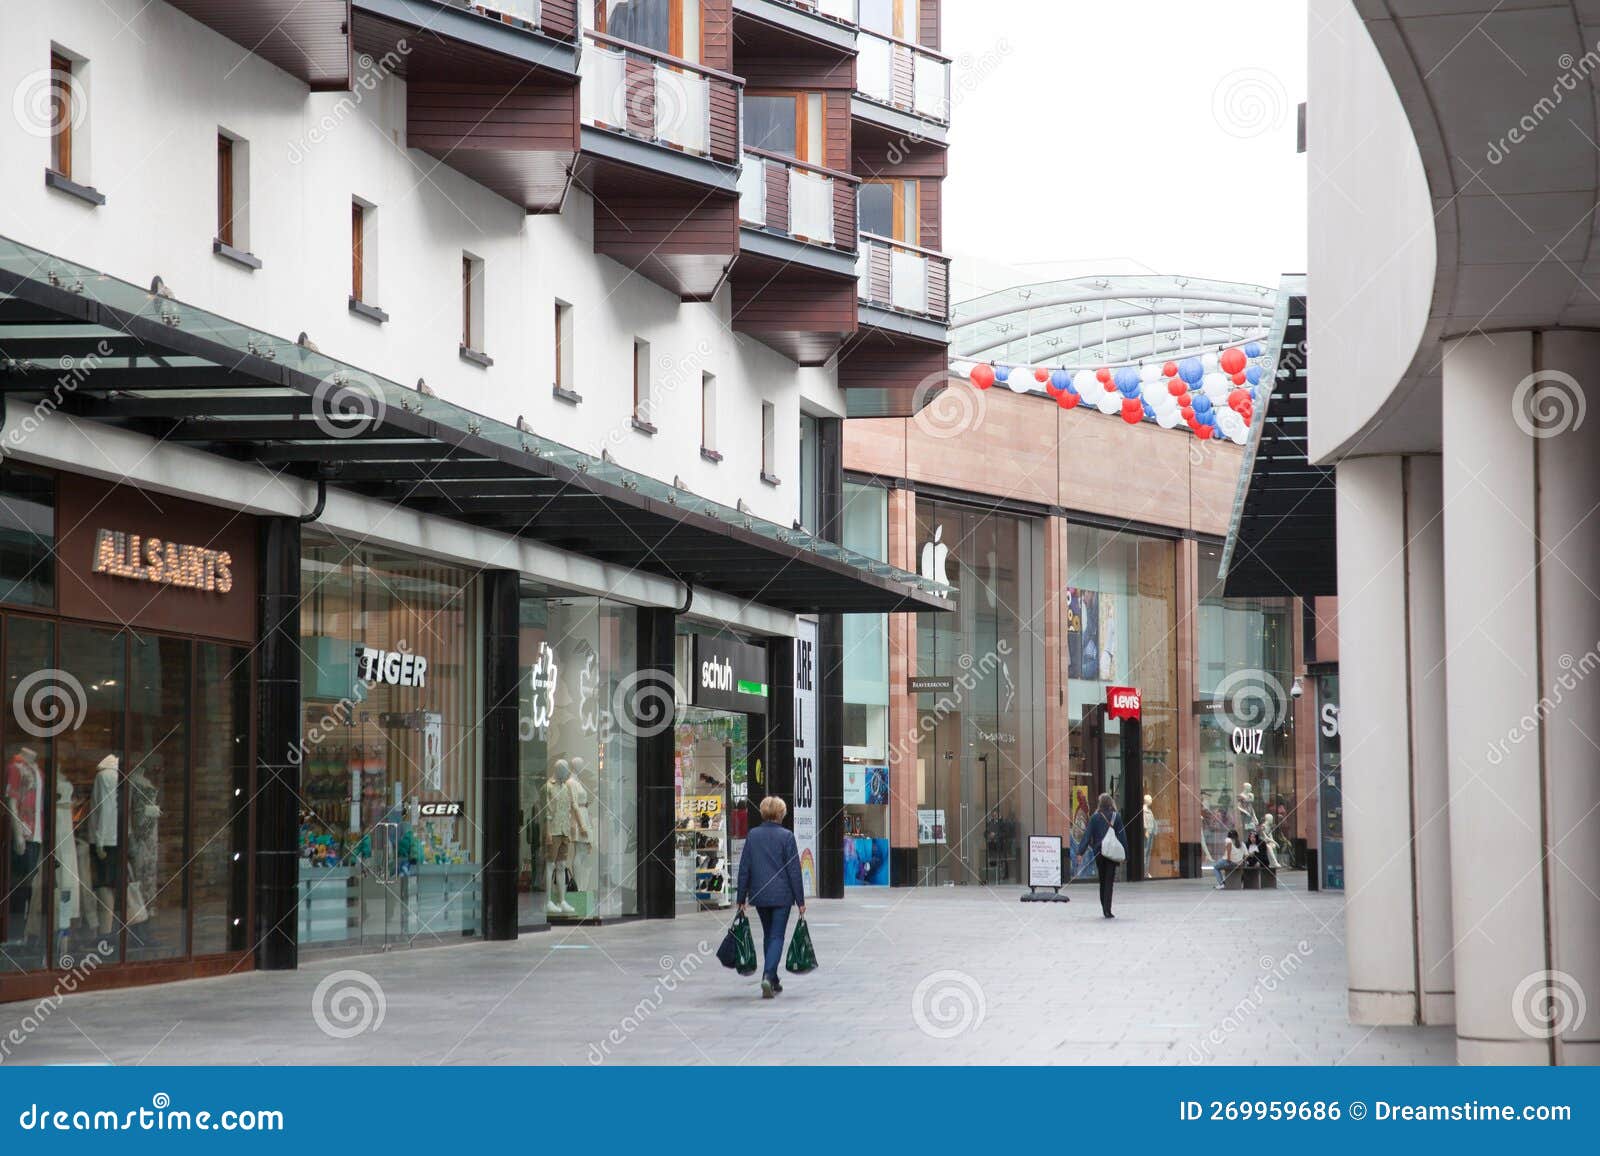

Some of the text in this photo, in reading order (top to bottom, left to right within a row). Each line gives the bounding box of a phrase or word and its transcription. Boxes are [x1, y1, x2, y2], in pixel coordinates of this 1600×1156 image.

[362, 647, 427, 688] TIGER
[702, 654, 732, 691] schuh
[1232, 727, 1263, 755] QUIZ
